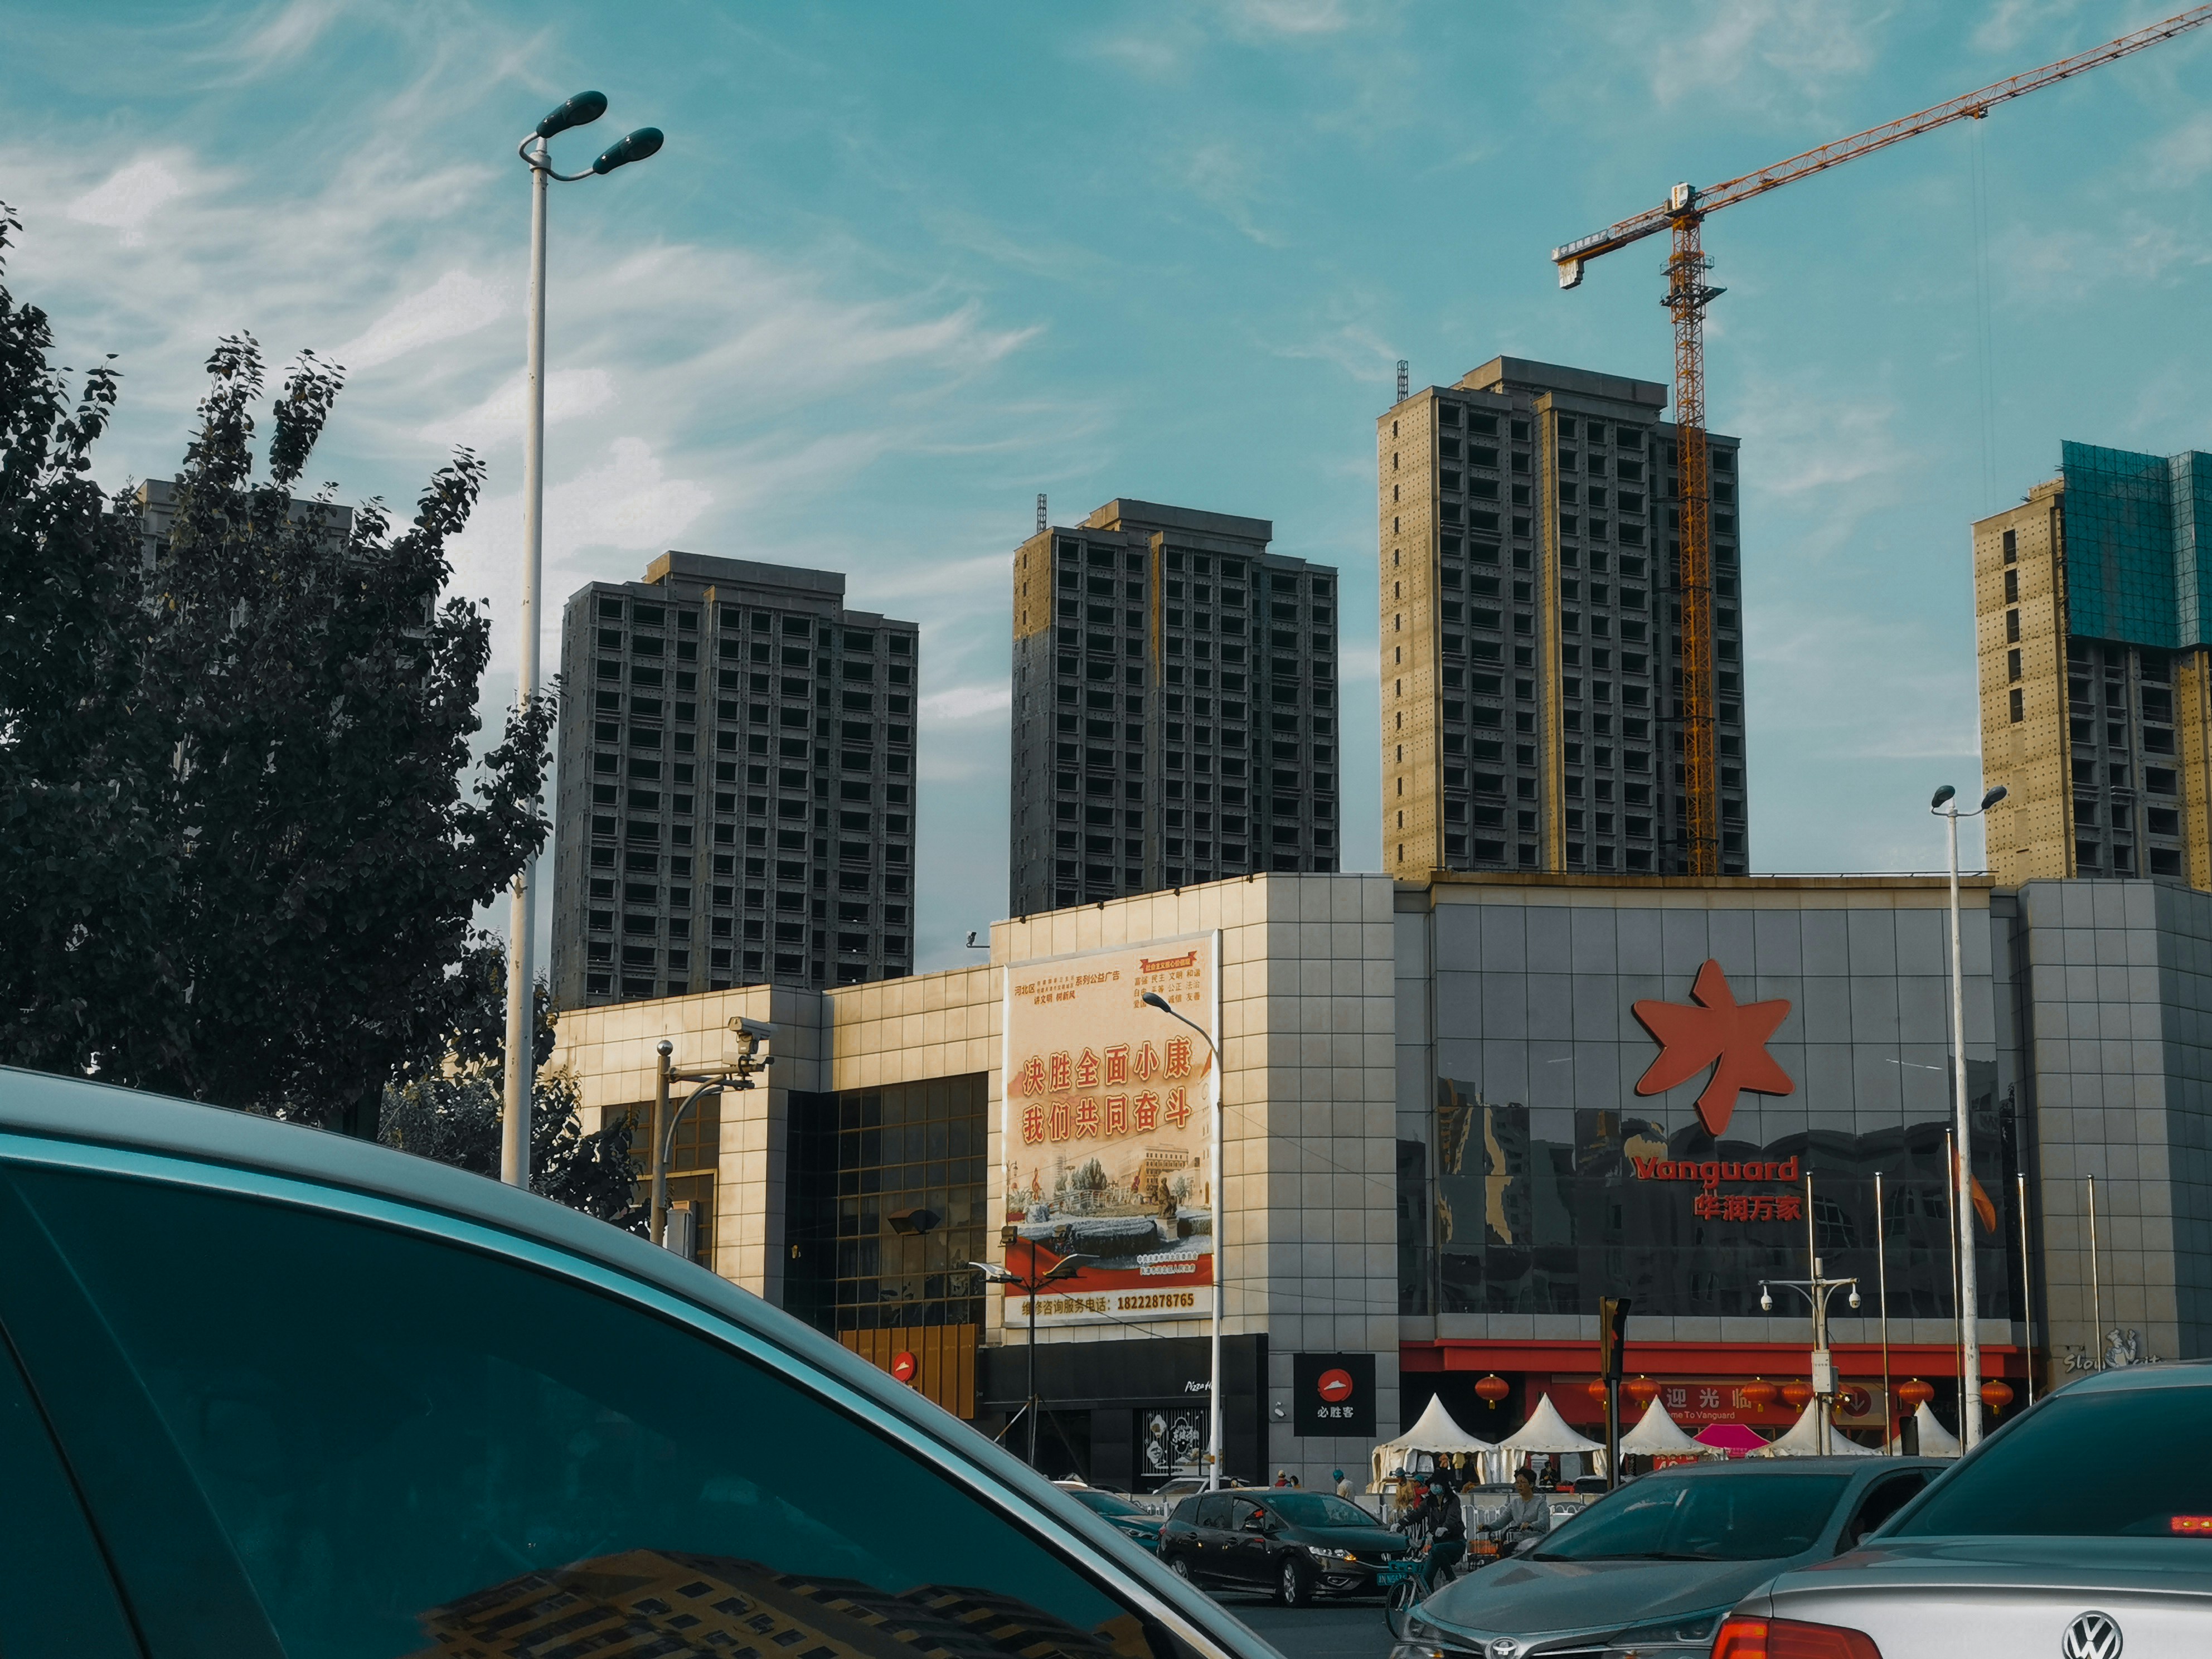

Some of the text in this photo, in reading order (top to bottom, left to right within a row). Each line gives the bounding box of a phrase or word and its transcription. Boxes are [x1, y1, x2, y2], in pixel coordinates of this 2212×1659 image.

[1015, 970, 1120, 996] 河北区 系列公益广告
[1152, 973, 1165, 983] 民主
[1168, 971, 1182, 981] 文明
[1168, 983, 1182, 992] 公正
[1023, 1036, 1192, 1095] 决胜全面小康
[1023, 1087, 1191, 1143] 我们共同奋斗
[1633, 1155, 1798, 1189] Vanguard
[1694, 1194, 1802, 1221] 华润万家
[1117, 1293, 1194, 1310] 18222878765
[1185, 1381, 1204, 1393] Pizza
[1317, 1406, 1354, 1418] 必胜客
[1696, 1411, 1735, 1420] Vanguard
